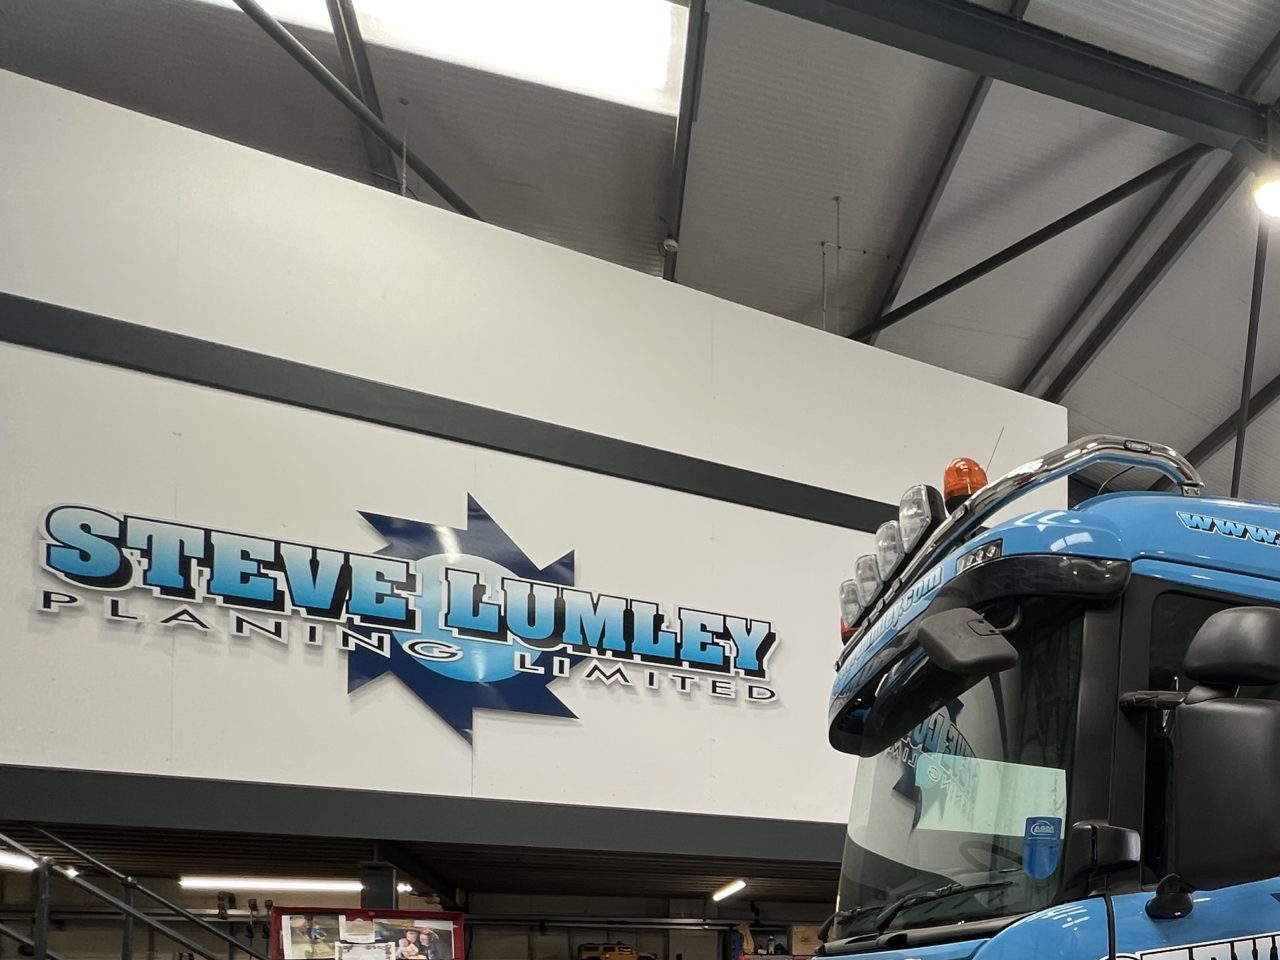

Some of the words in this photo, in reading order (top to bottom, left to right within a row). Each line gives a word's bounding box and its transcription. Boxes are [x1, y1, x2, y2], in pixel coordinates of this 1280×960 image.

[38, 590, 464, 662] PLANING
[515, 650, 776, 702] LIMITED
[41, 503, 421, 631] STEVE
[442, 566, 779, 680] LUMLEY
